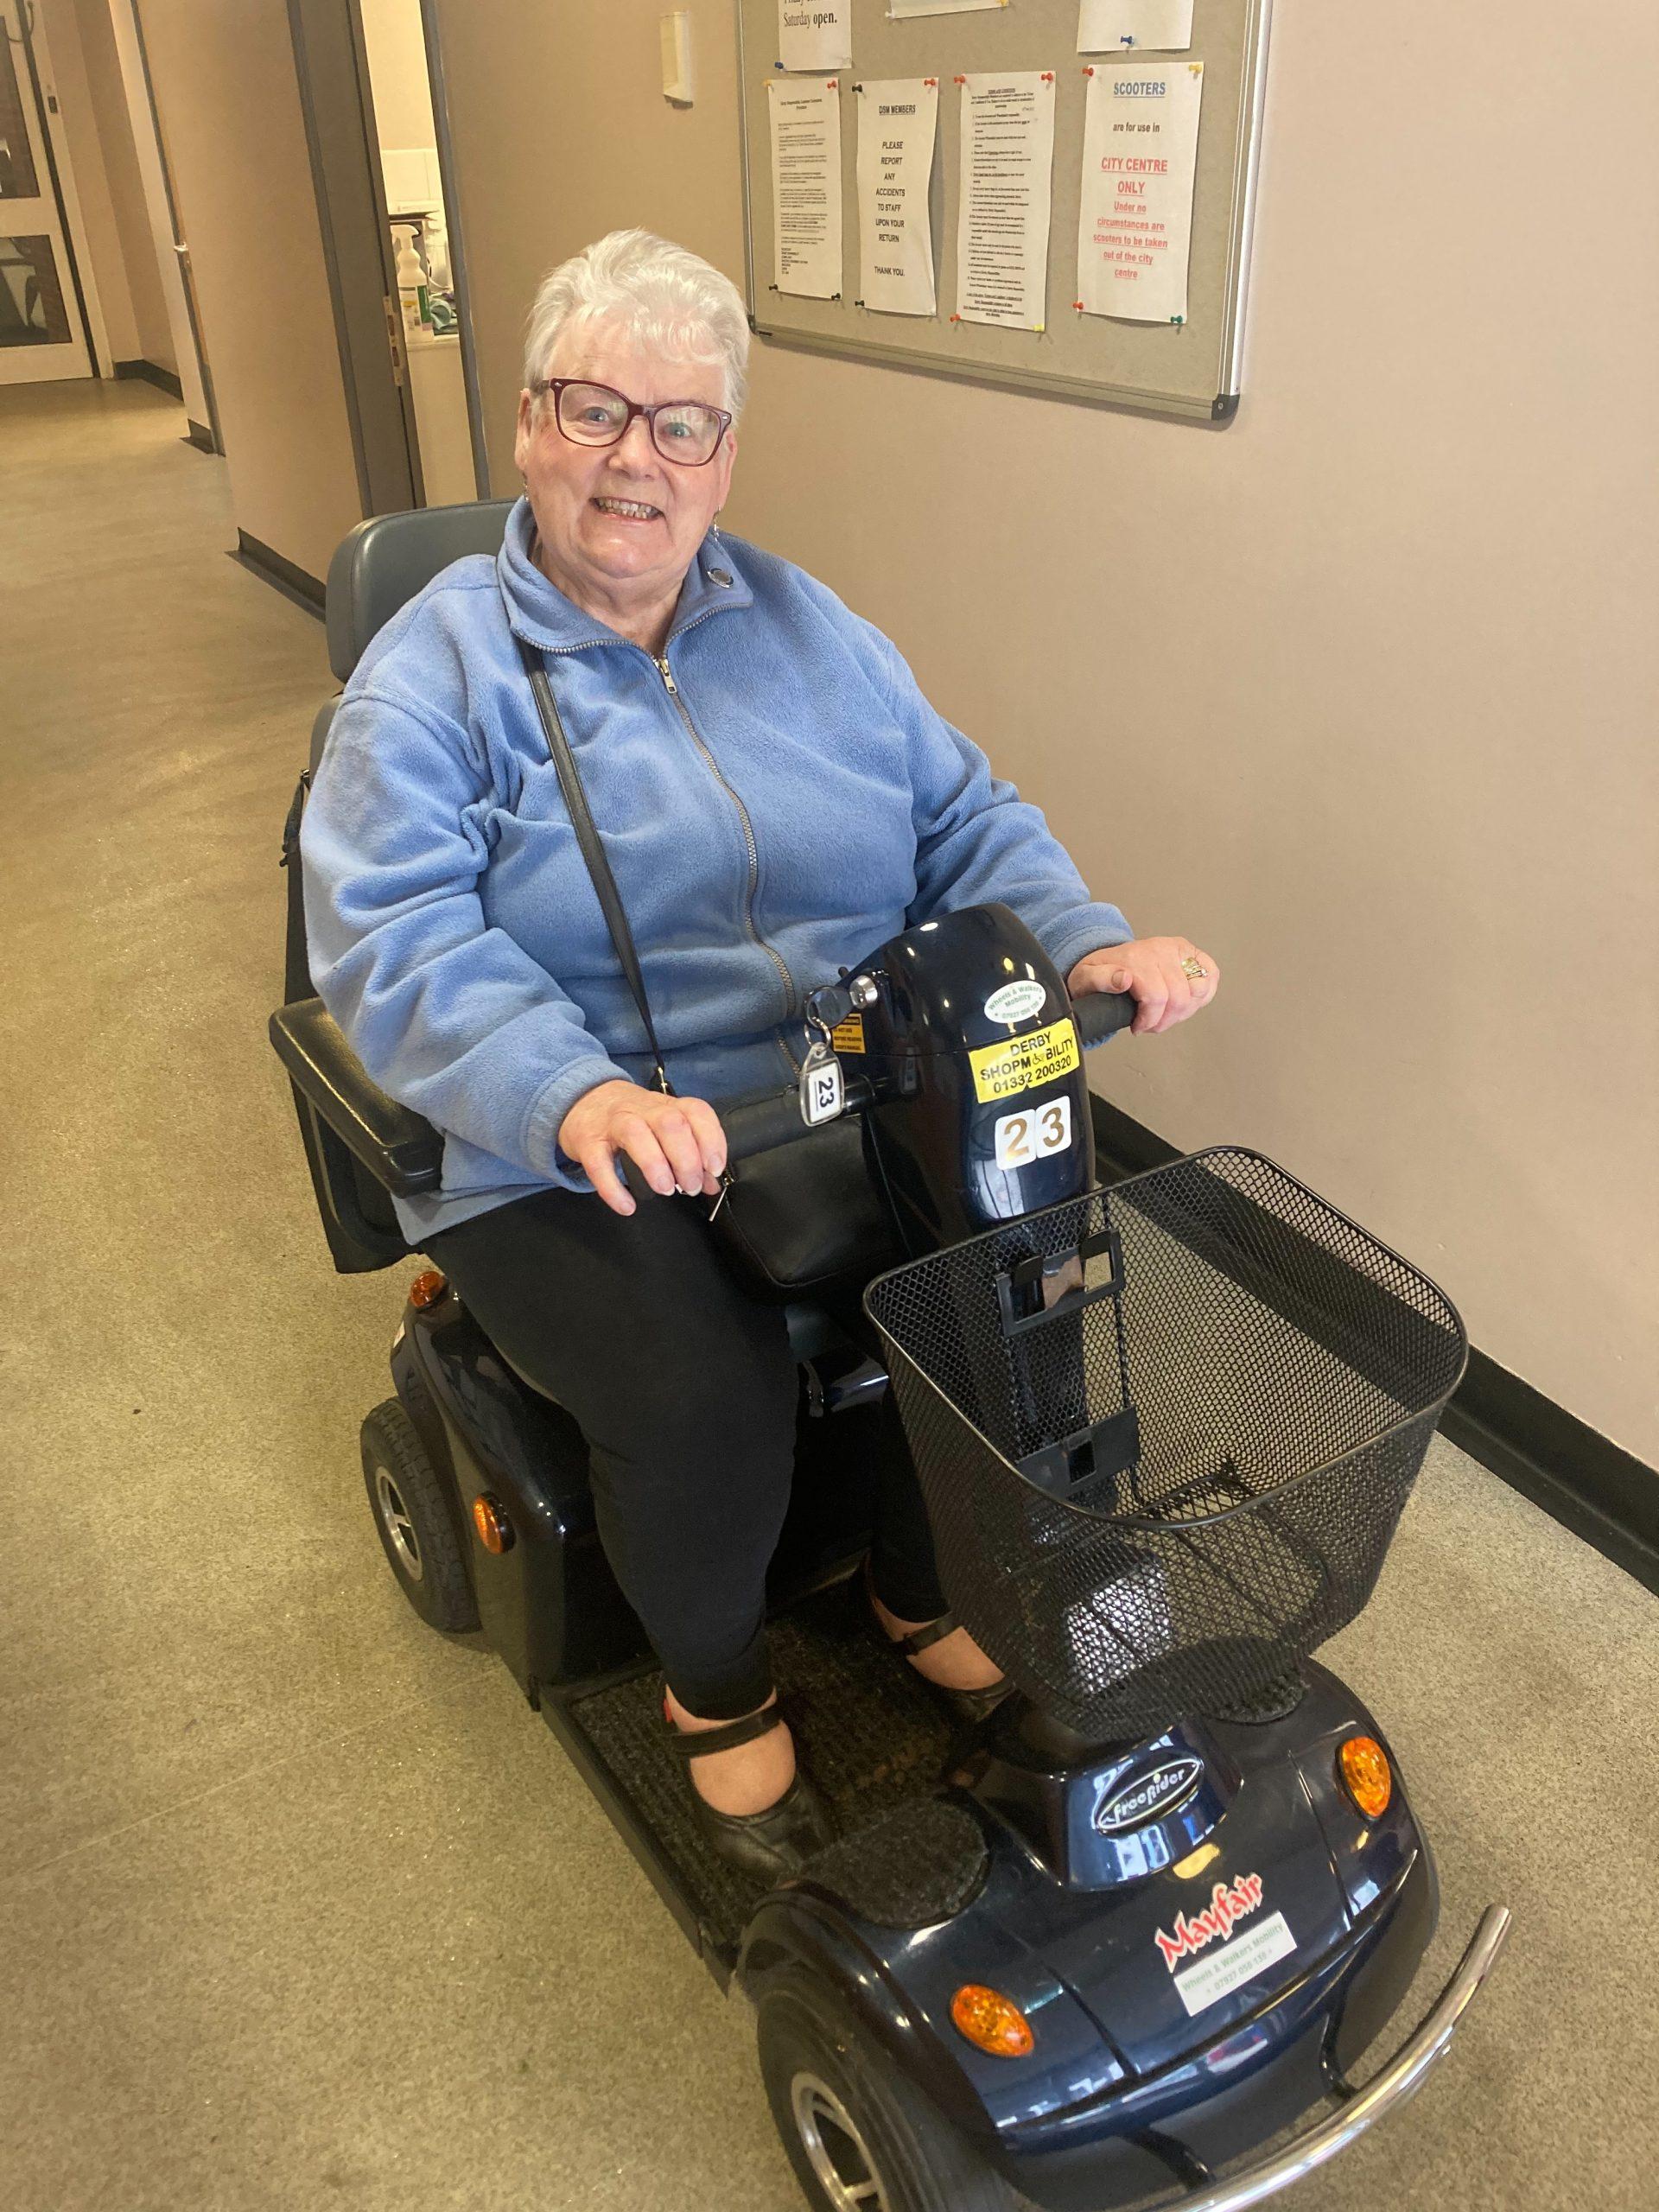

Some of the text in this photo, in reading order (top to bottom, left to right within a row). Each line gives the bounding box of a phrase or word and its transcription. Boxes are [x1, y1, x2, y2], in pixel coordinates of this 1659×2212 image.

[783, 10, 837, 29] Saturday open.
[1113, 82, 1166, 95] SCOOTERS
[879, 105, 916, 114] DSM MEMBERS
[1126, 122, 1136, 131] for
[1137, 124, 1150, 132] use
[1153, 123, 1160, 133] in
[881, 141, 904, 149] PLEASE
[880, 156, 903, 165] REPORT
[1101, 156, 1168, 172] CITY CENTRE
[883, 172, 896, 181] ANY
[875, 188, 906, 197] ACCIDENTS
[1117, 180, 1145, 194] ONLY
[877, 203, 902, 213] TO STAFF
[1114, 200, 1147, 213] Under no
[875, 218, 905, 228] UPON YOUR
[1096, 217, 1149, 229] circumstances
[878, 233, 899, 243] RETURN
[1093, 233, 1168, 248] scooters to be taken
[1103, 251, 1114, 260] out
[1125, 251, 1136, 262] the
[1138, 253, 1154, 265] city
[874, 266, 892, 276] THANK
[1114, 269, 1138, 278] centre
[988, 992, 1011, 1009] Wheels
[1005, 994, 1031, 1007] Mobility
[1009, 1031, 1052, 1057] DERBY
[993, 1055, 1071, 1093] 01332 200320
[818, 1077, 835, 1108] 23
[1004, 1107, 1065, 1156] 23
[1155, 1872, 1262, 1974] Mayfair
[1181, 1923, 1284, 1992] Wheels & Walkers Mobility
